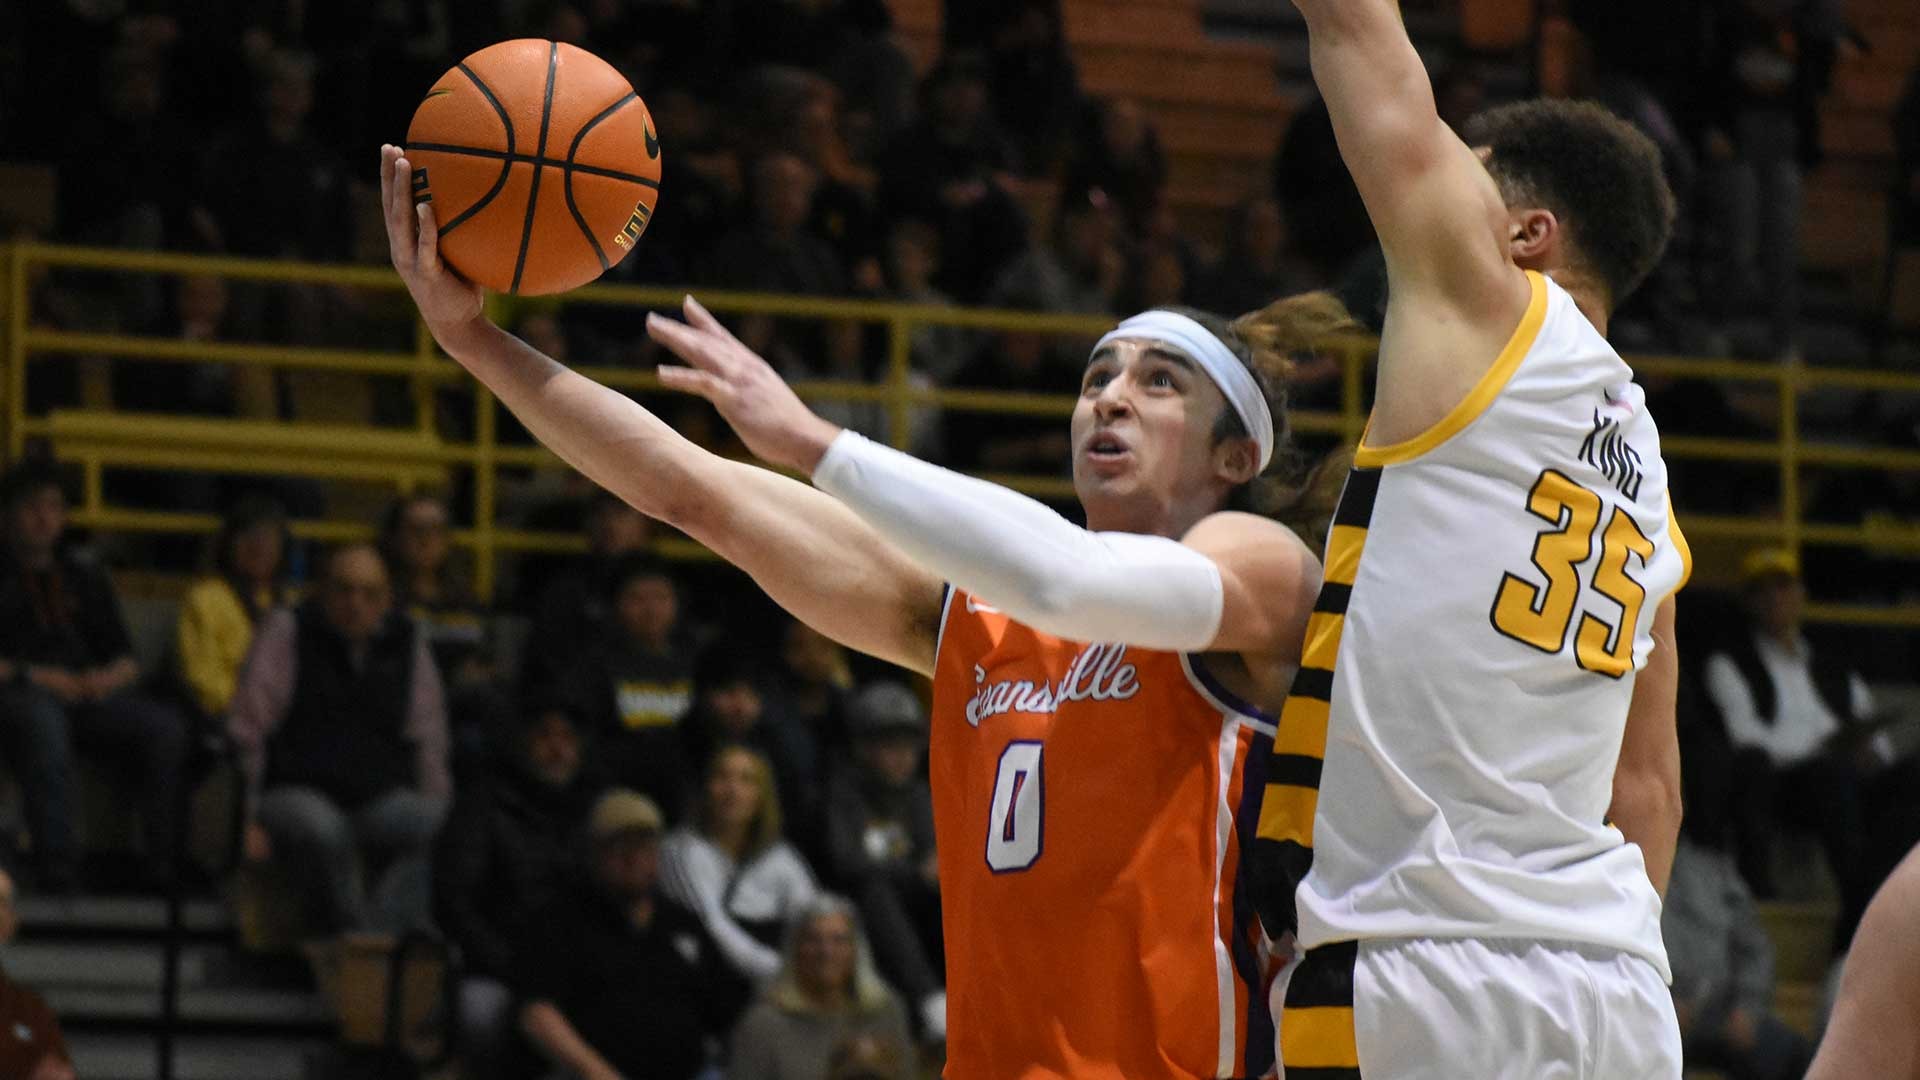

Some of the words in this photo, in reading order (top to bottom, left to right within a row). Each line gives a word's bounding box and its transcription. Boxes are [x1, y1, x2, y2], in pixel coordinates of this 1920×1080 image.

[1578, 406, 1643, 504] KING
[1490, 469, 1655, 679] 35
[985, 738, 1045, 875] 0
